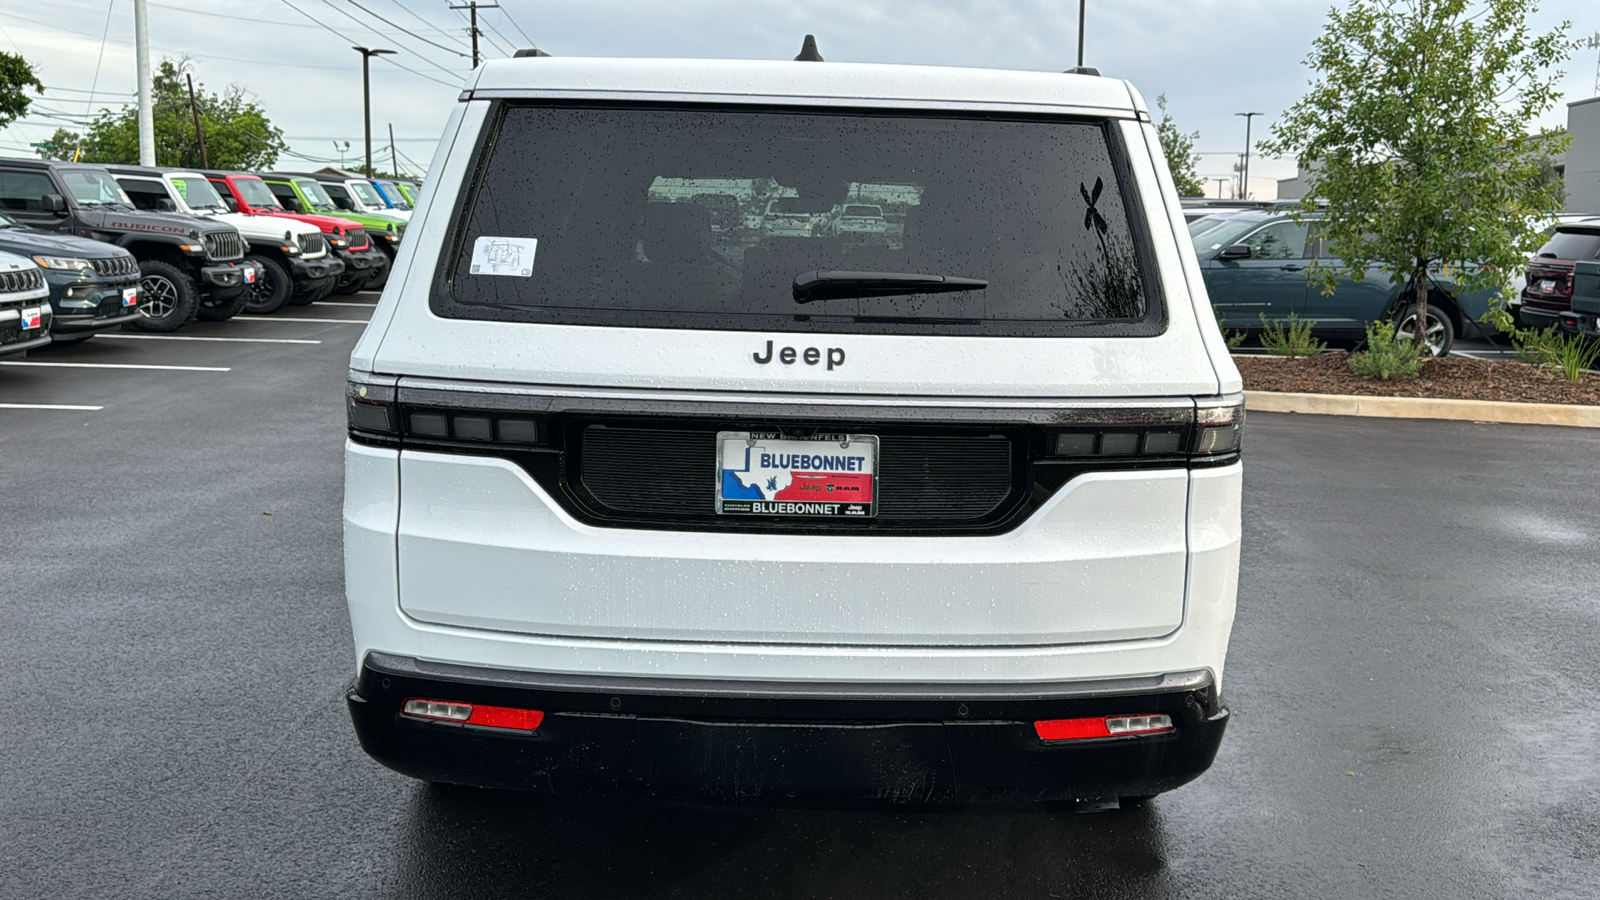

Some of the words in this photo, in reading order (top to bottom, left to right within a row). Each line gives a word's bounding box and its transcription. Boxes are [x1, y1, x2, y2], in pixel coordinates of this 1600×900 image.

[111, 222, 185, 233] RUBICON
[753, 340, 846, 371] Jeep
[751, 432, 777, 440] NEW
[760, 453, 866, 472] BLUEBONNET
[799, 483, 822, 492] Jeep
[752, 502, 841, 515] BLUEBONNET
